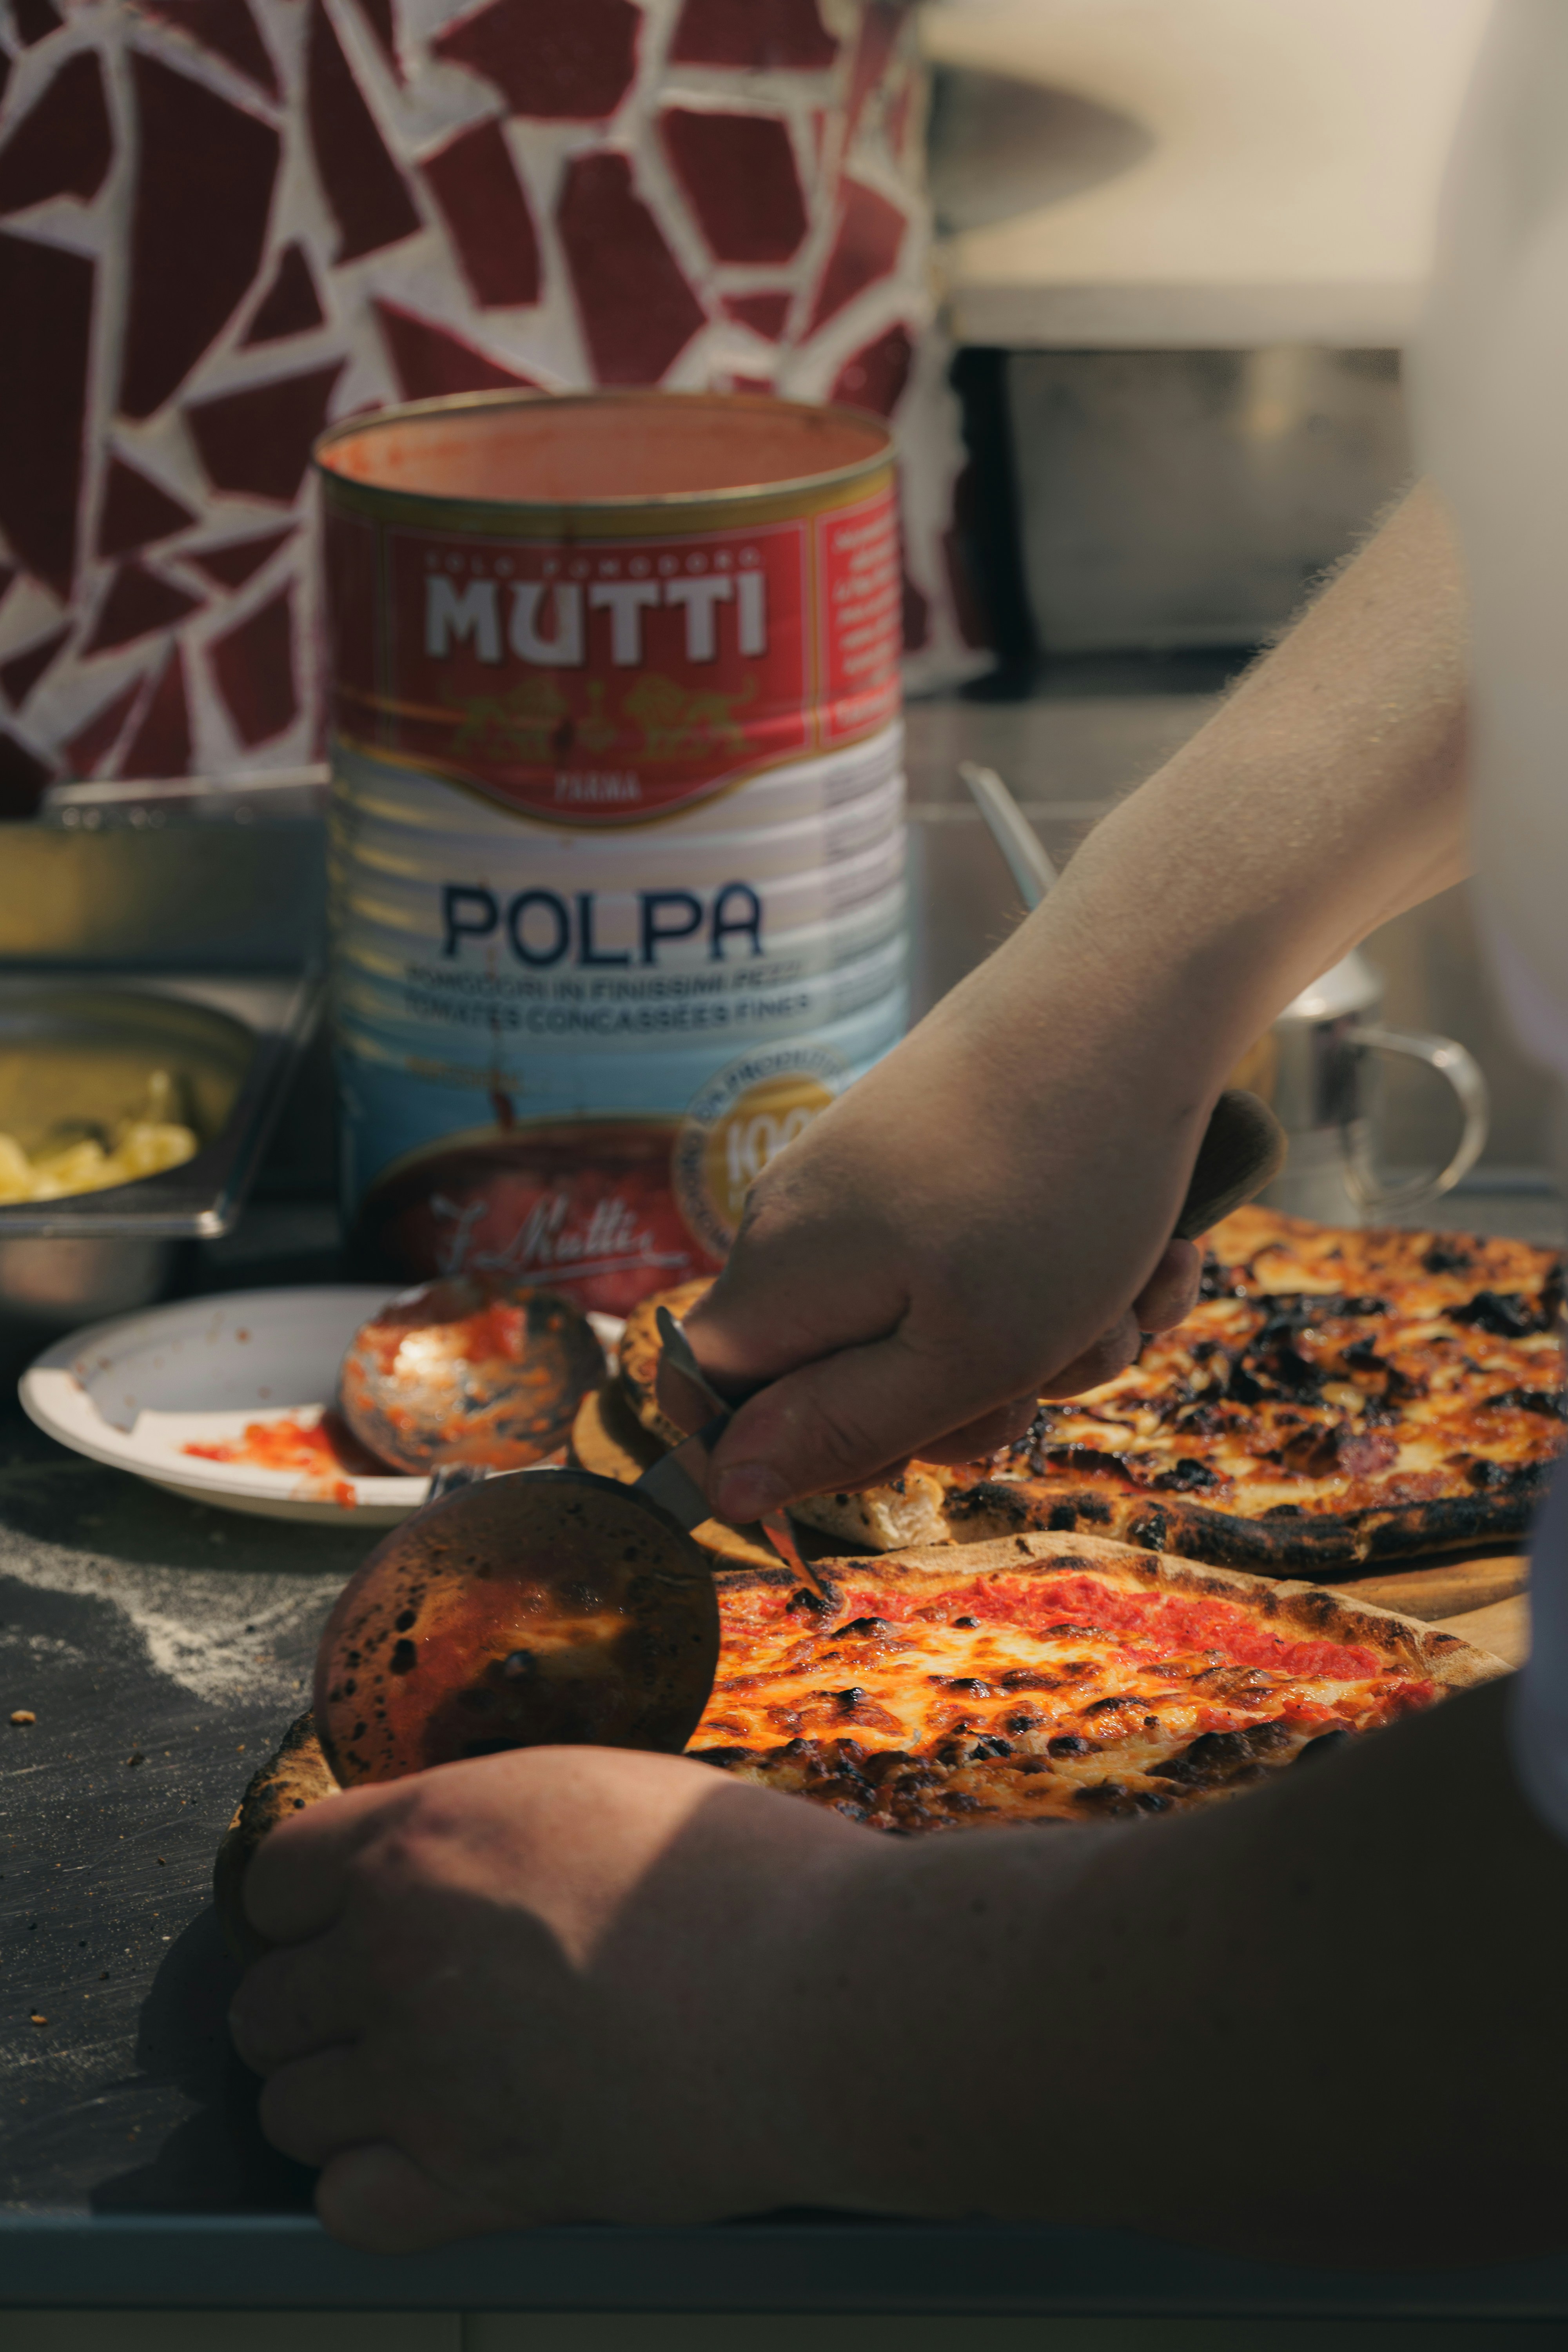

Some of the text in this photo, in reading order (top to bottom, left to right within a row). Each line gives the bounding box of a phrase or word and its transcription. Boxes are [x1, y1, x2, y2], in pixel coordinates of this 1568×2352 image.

[423, 548, 762, 580] SOLO POMODORO
[425, 572, 765, 666] MUTTI
[554, 771, 642, 803] PARMA
[441, 881, 765, 967] POLPA
[551, 980, 585, 1003] IN
[591, 973, 723, 1003] FINISSIMI
[734, 992, 811, 1025] FINES
